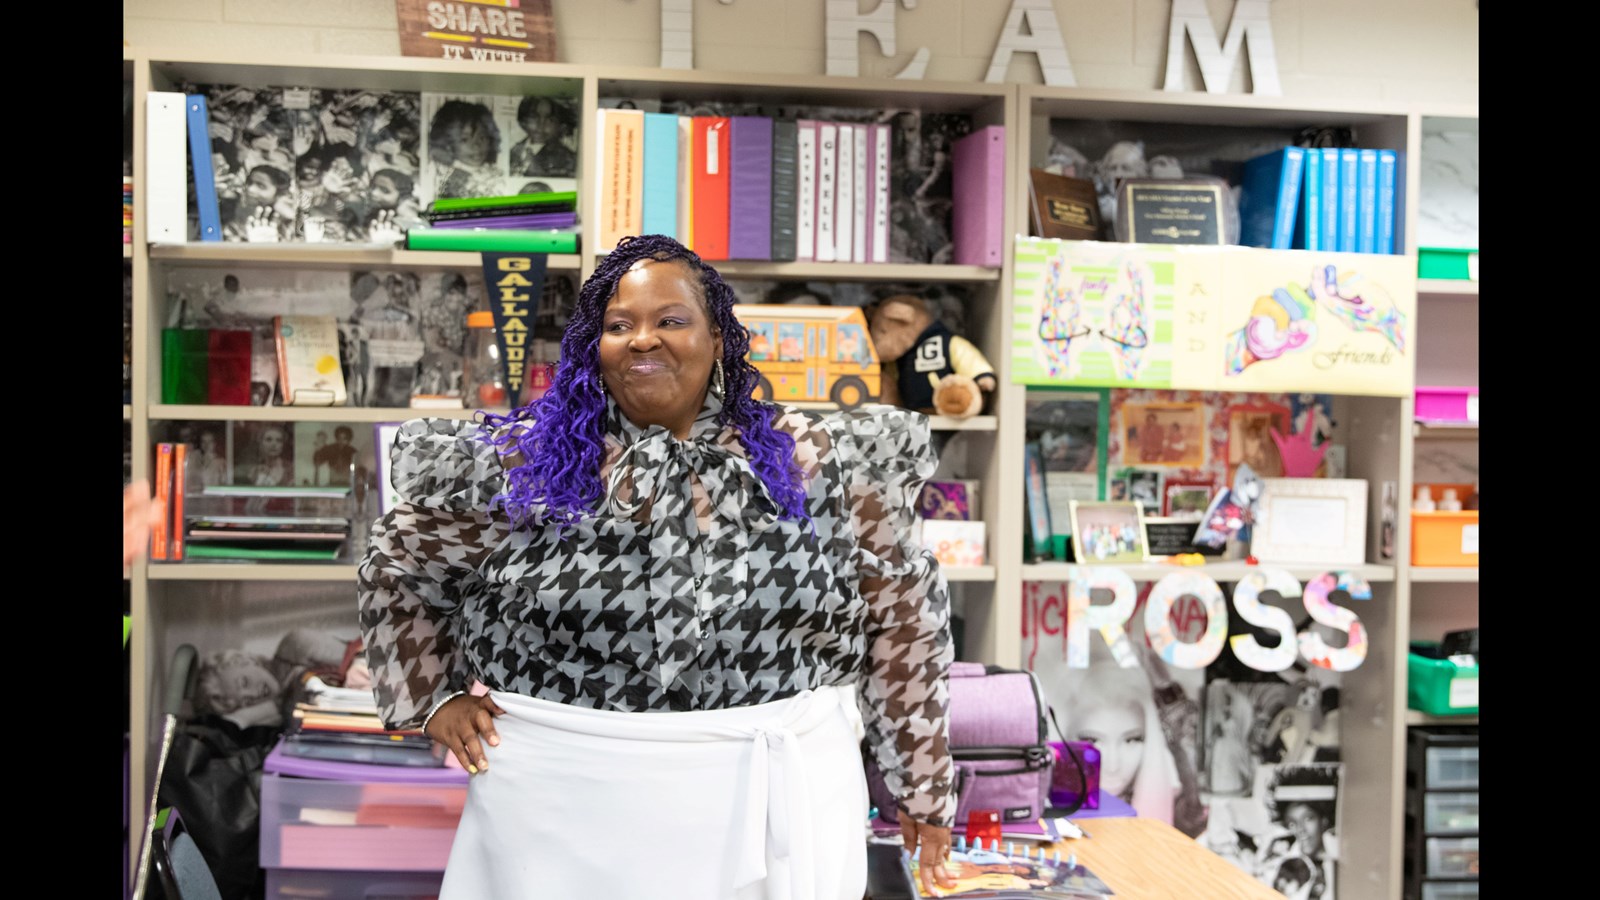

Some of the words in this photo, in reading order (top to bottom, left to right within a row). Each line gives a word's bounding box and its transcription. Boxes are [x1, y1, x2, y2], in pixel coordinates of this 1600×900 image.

[427, 1, 527, 38] SHARE
[441, 44, 465, 60] IT
[469, 47, 527, 63] WITH
[496, 257, 533, 391] GALLAUDET
[922, 341, 938, 360] G
[1067, 566, 1373, 672] ROSS
